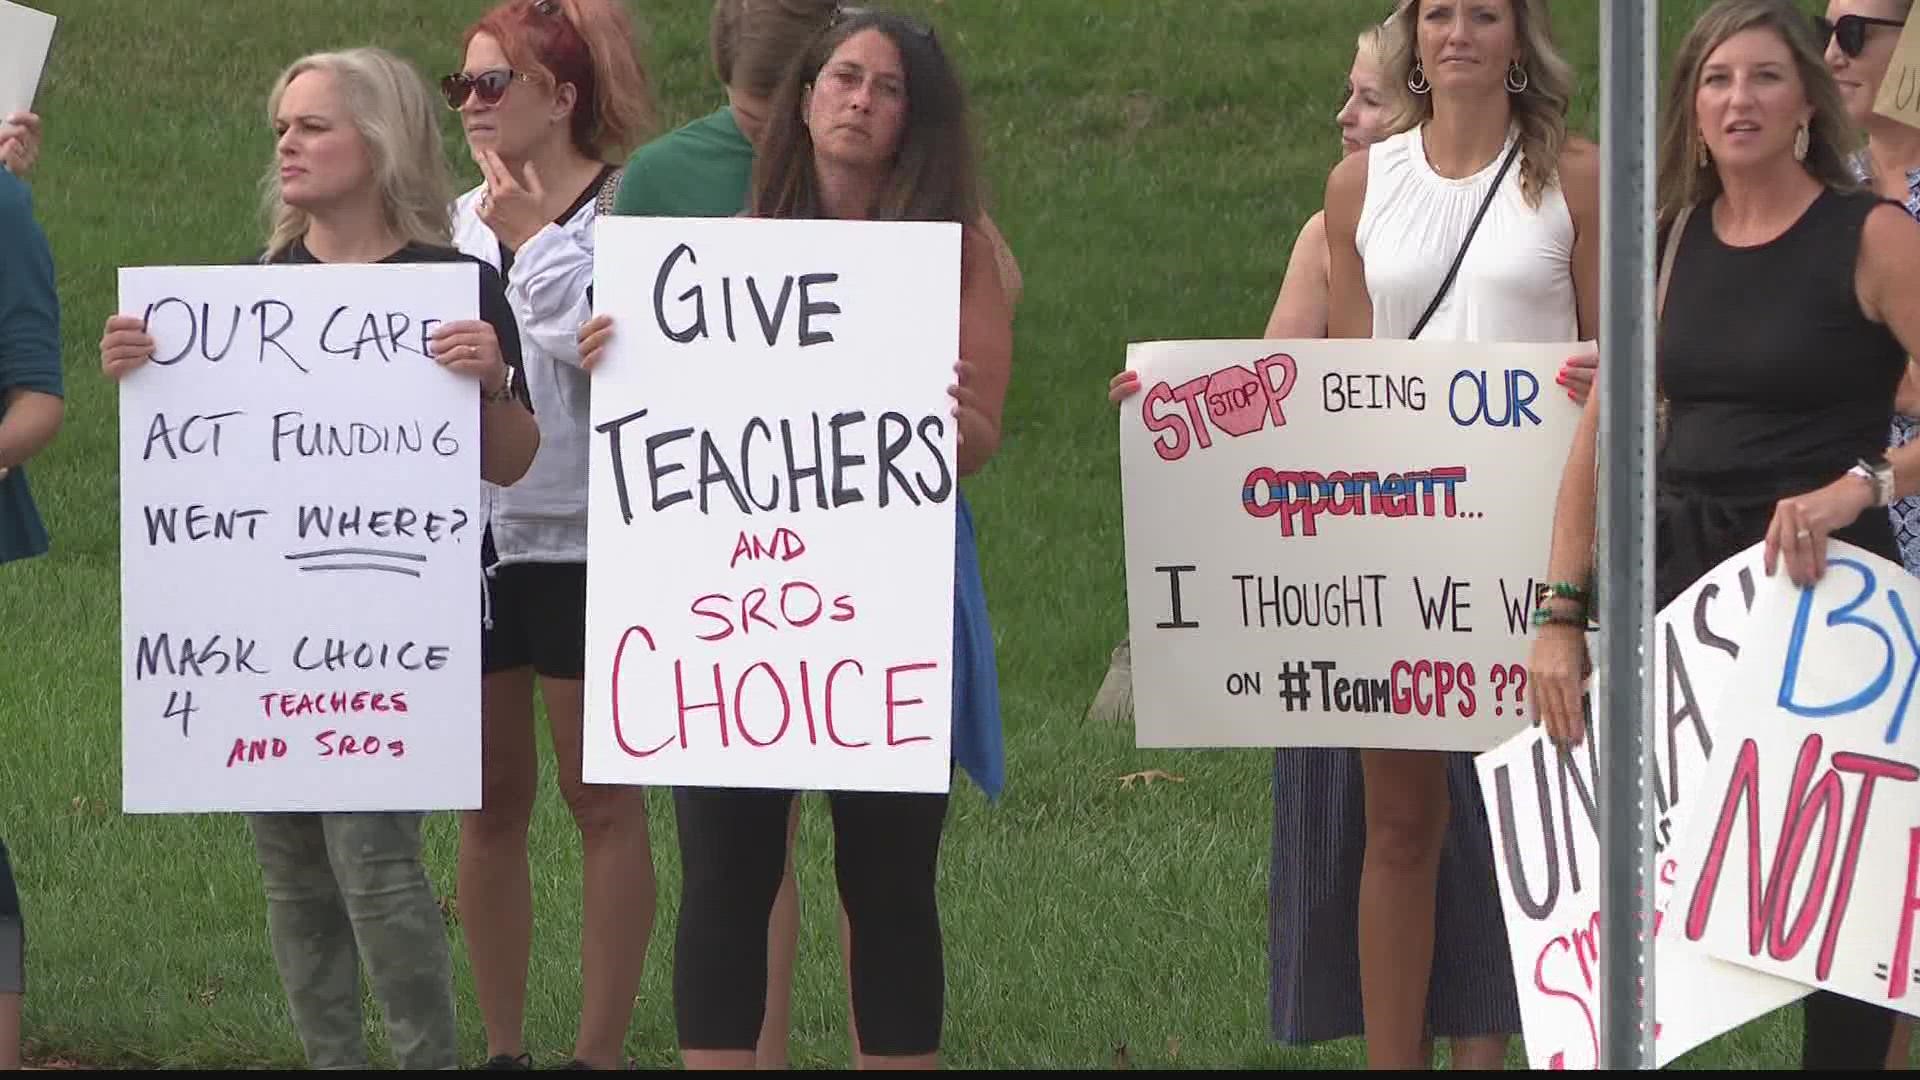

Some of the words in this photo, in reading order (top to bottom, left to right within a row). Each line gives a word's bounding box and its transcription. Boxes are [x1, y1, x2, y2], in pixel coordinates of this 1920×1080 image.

[653, 243, 842, 347] GIVE
[141, 296, 309, 373] OUR
[319, 305, 441, 362] CARE
[1142, 353, 1298, 461] STOP
[1322, 373, 1427, 412] BEING
[1448, 369, 1542, 427] OUR
[1209, 382, 1259, 417] STOP
[143, 411, 247, 459] ACT
[272, 412, 460, 461] FUNDING
[595, 409, 953, 524] TEACHERS
[143, 505, 267, 546] WENT
[298, 505, 469, 544] WHERE?
[730, 527, 806, 568] AND
[690, 581, 856, 641] SROs
[1154, 565, 1199, 629] I
[1232, 574, 1387, 628] THOUGHT
[1413, 576, 1472, 633] WE
[136, 633, 269, 681] MASK
[293, 637, 450, 673] CHOICE
[1777, 557, 1920, 744] BY
[163, 691, 197, 737] 4
[259, 691, 408, 717] TEACHERS
[611, 625, 937, 758] CHOICE
[1226, 672, 1261, 695] ON
[1278, 659, 1477, 717] #TeamGCPS
[1490, 663, 1528, 716] ??
[226, 737, 288, 768] AND
[1686, 733, 1919, 981] NOT
